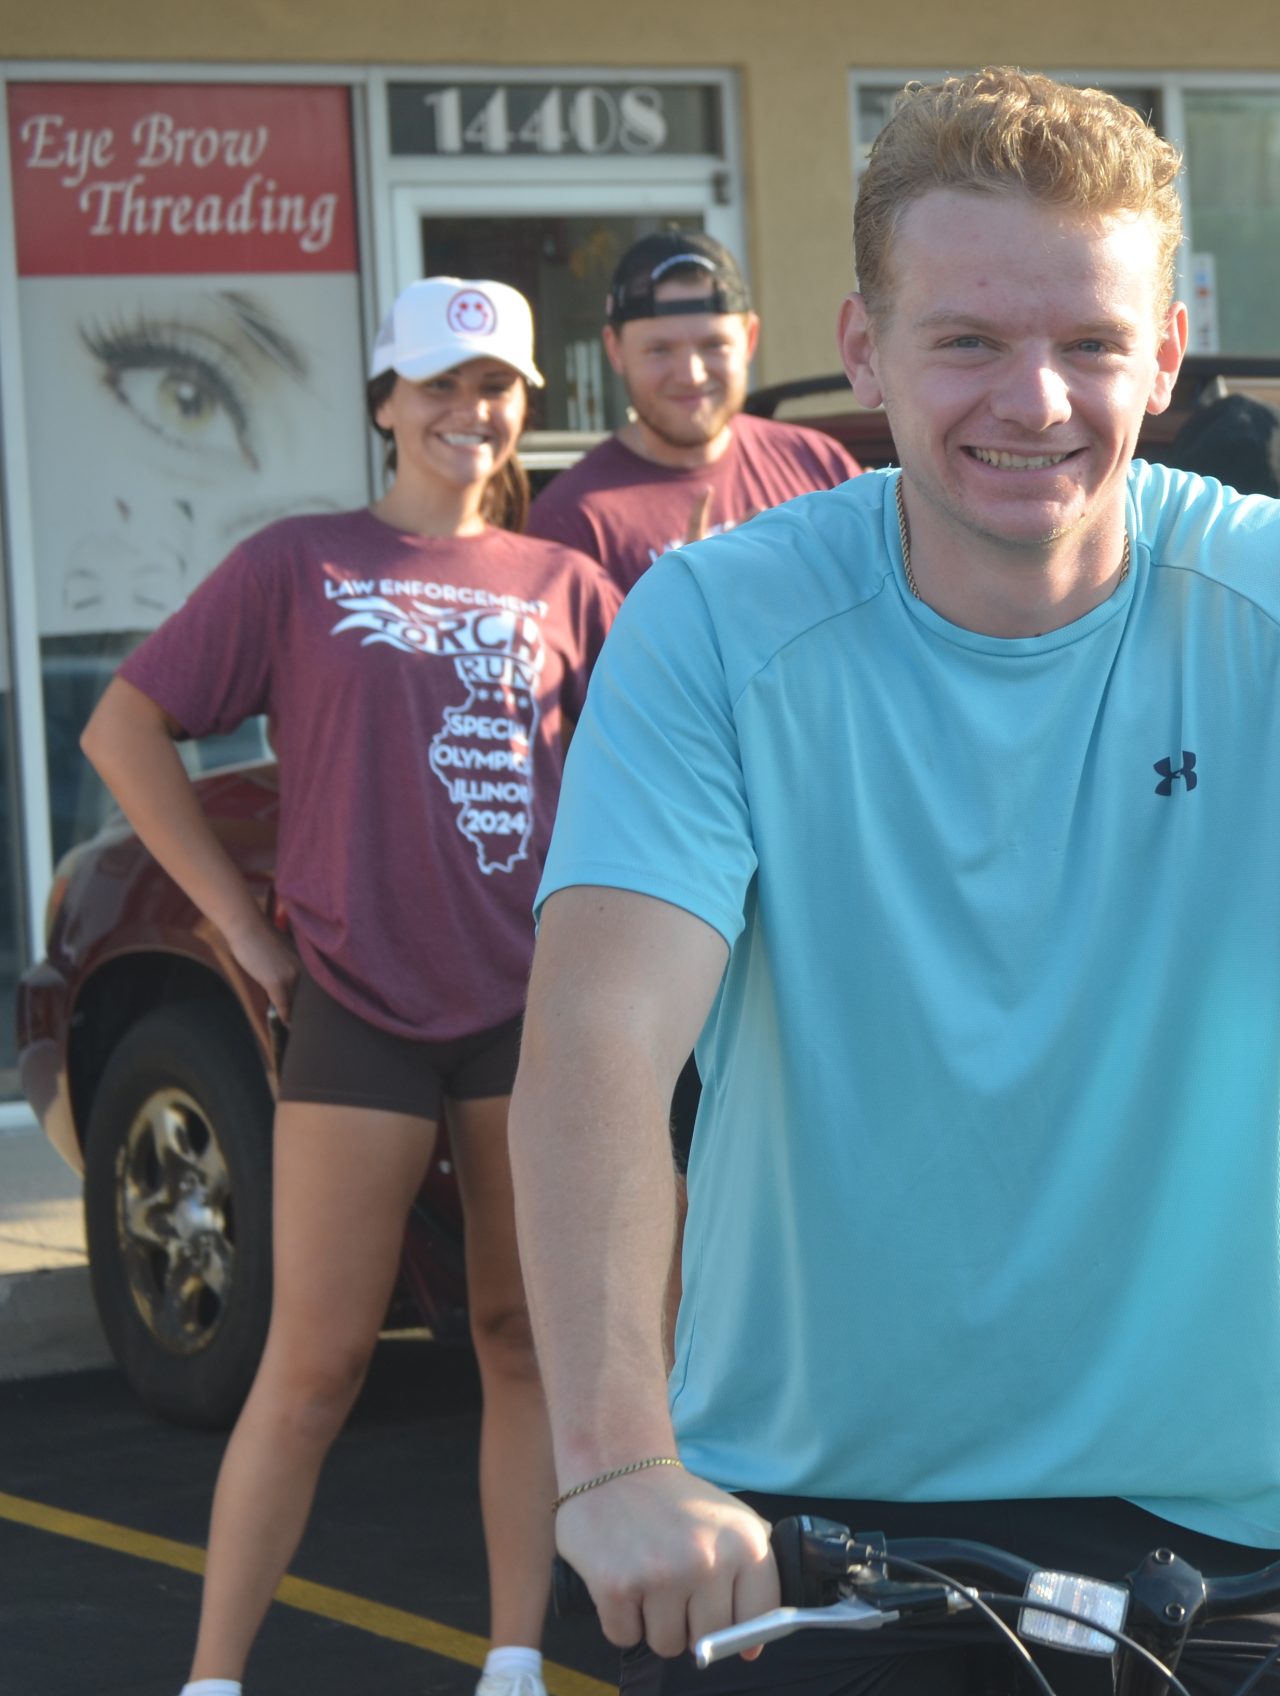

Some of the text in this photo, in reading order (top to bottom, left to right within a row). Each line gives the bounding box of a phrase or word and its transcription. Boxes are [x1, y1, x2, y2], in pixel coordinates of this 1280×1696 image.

[424, 86, 667, 154] 14408
[20, 112, 269, 188] Eye Brow
[79, 172, 338, 253] Threading
[323, 578, 549, 618] LAW ENFORCEMENT
[460, 655, 536, 690] RUN
[449, 713, 529, 746] SPECI
[433, 744, 532, 777] OLYMPIC
[466, 809, 527, 835] 2024
